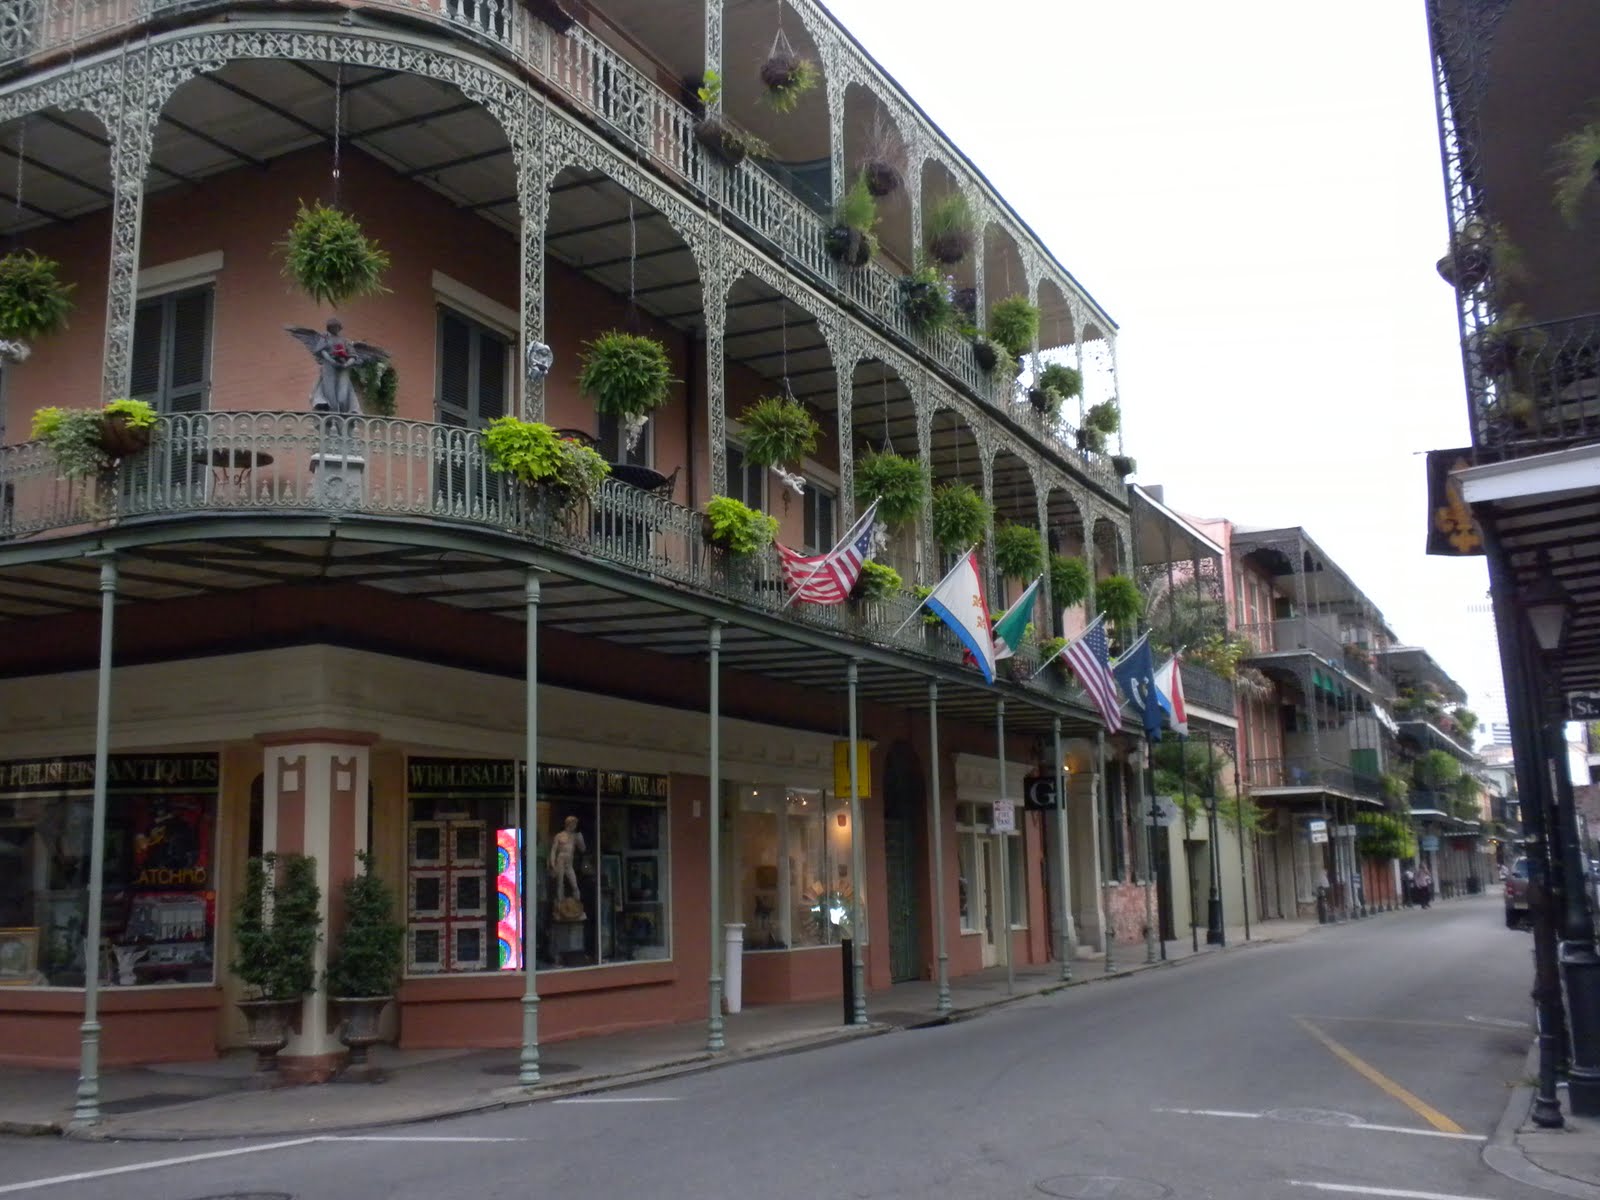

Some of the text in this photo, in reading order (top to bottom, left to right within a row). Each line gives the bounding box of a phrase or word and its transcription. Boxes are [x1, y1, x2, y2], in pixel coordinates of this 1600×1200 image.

[1576, 701, 1599, 715] St.
[108, 759, 218, 784] ANTIQUES
[411, 764, 514, 786] WHOLESALE
[629, 775, 649, 795] FINE
[1030, 780, 1057, 806] G
